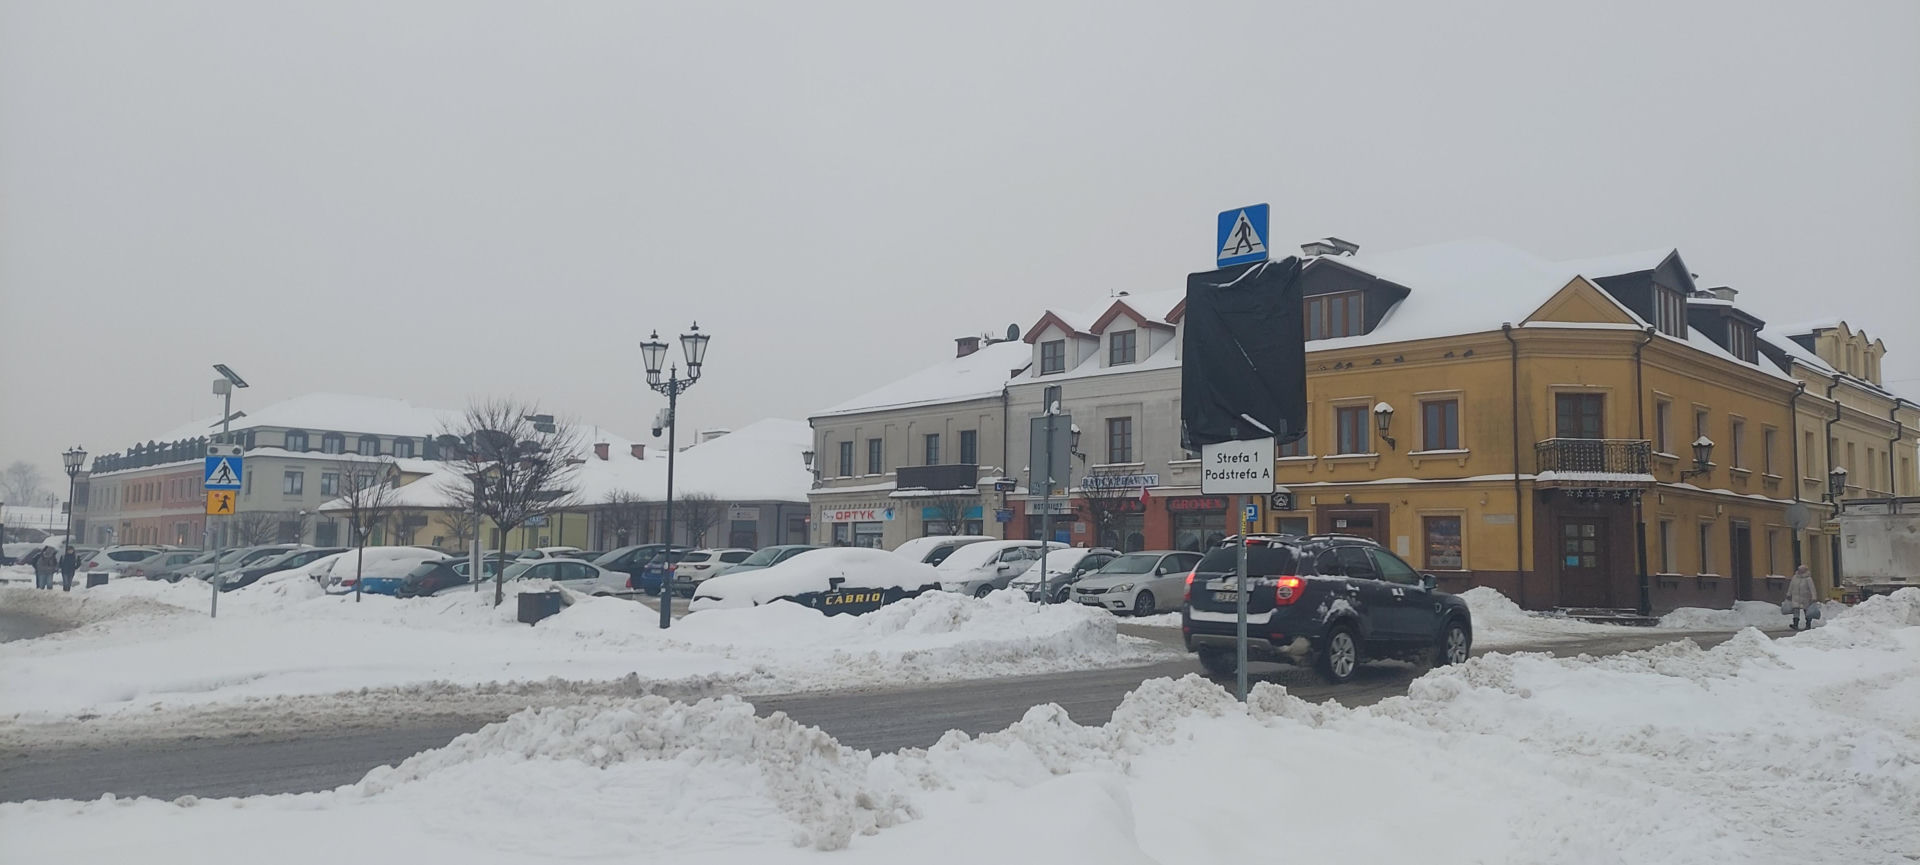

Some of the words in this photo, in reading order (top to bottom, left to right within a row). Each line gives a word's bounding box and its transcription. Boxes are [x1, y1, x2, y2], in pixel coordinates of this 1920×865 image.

[1217, 451, 1249, 463] Strefa
[1254, 451, 1258, 462] 1
[1205, 468, 1257, 480] Podstrefa
[1262, 467, 1269, 478] A
[835, 510, 875, 520] OPTYK
[825, 593, 880, 605] CABRIO
